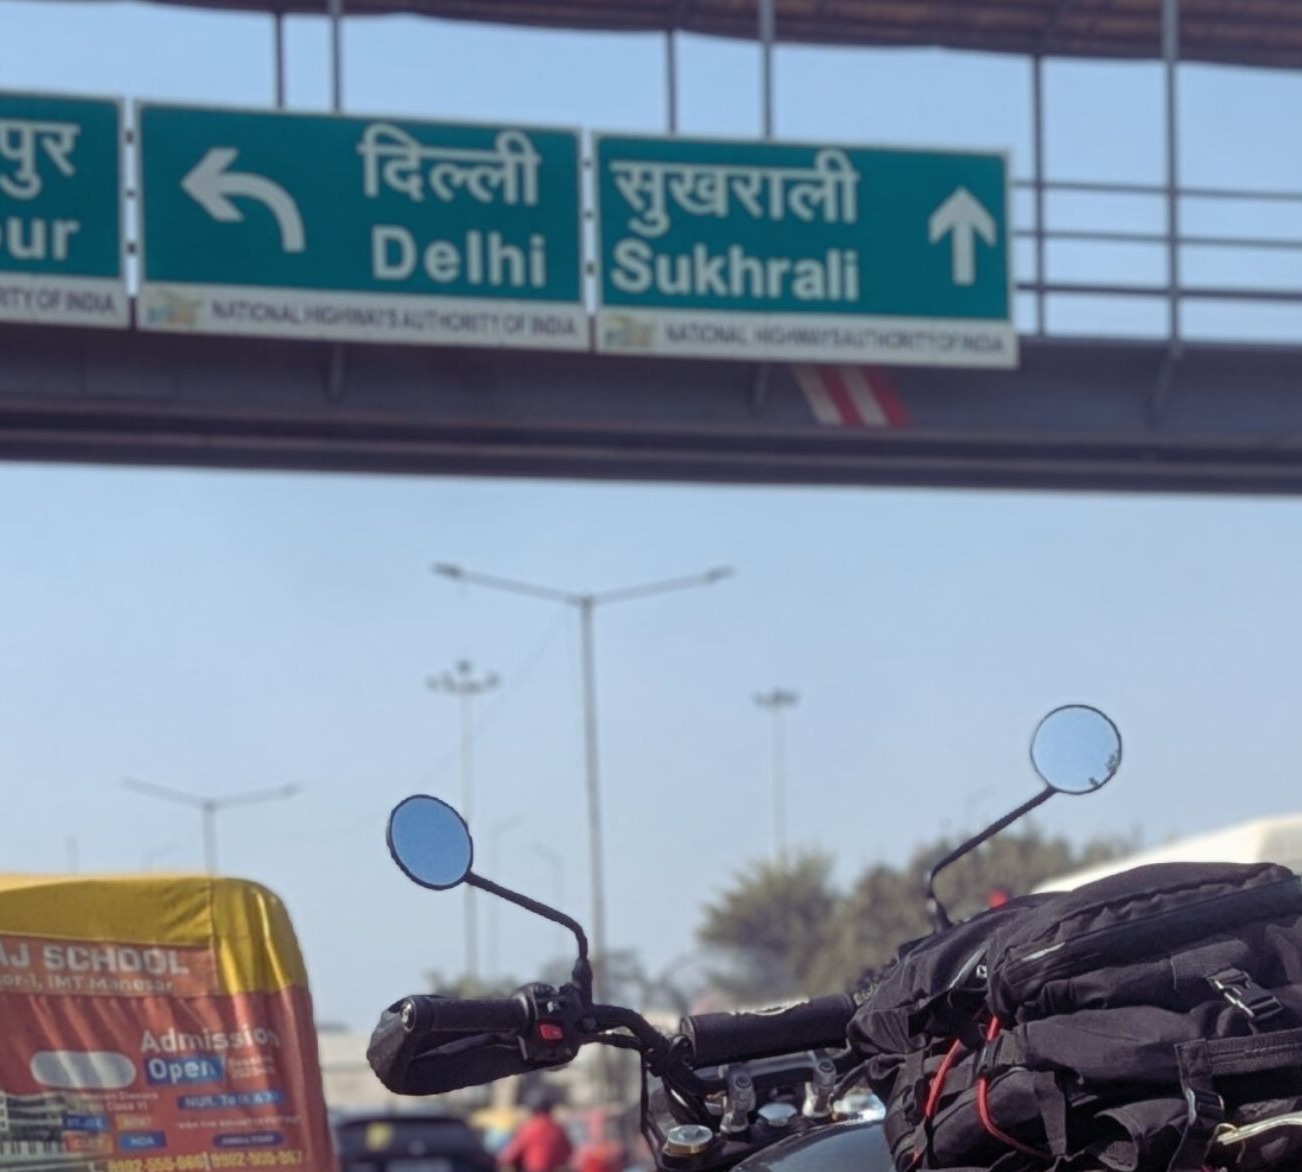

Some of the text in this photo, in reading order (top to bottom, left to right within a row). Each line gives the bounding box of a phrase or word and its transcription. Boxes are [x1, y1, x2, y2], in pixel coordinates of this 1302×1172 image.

[355, 122, 542, 206] दिल्ली
[609, 147, 860, 238] सुखराली
[371, 223, 548, 288] Delhi
[609, 238, 859, 302] Sukhrali
[35, 287, 61, 311] OF
[64, 289, 118, 315] INDIA
[211, 299, 302, 326] NATIONAL
[304, 304, 398, 331] HIGHWAYS
[402, 307, 499, 334] AUTHORITY
[531, 314, 579, 337] INDIA
[43, 942, 189, 976] SCHOOL
[48, 973, 84, 991] IMT
[89, 974, 173, 993] Manesar
[141, 1023, 281, 1054] Admission
[148, 1057, 218, 1085] Open
